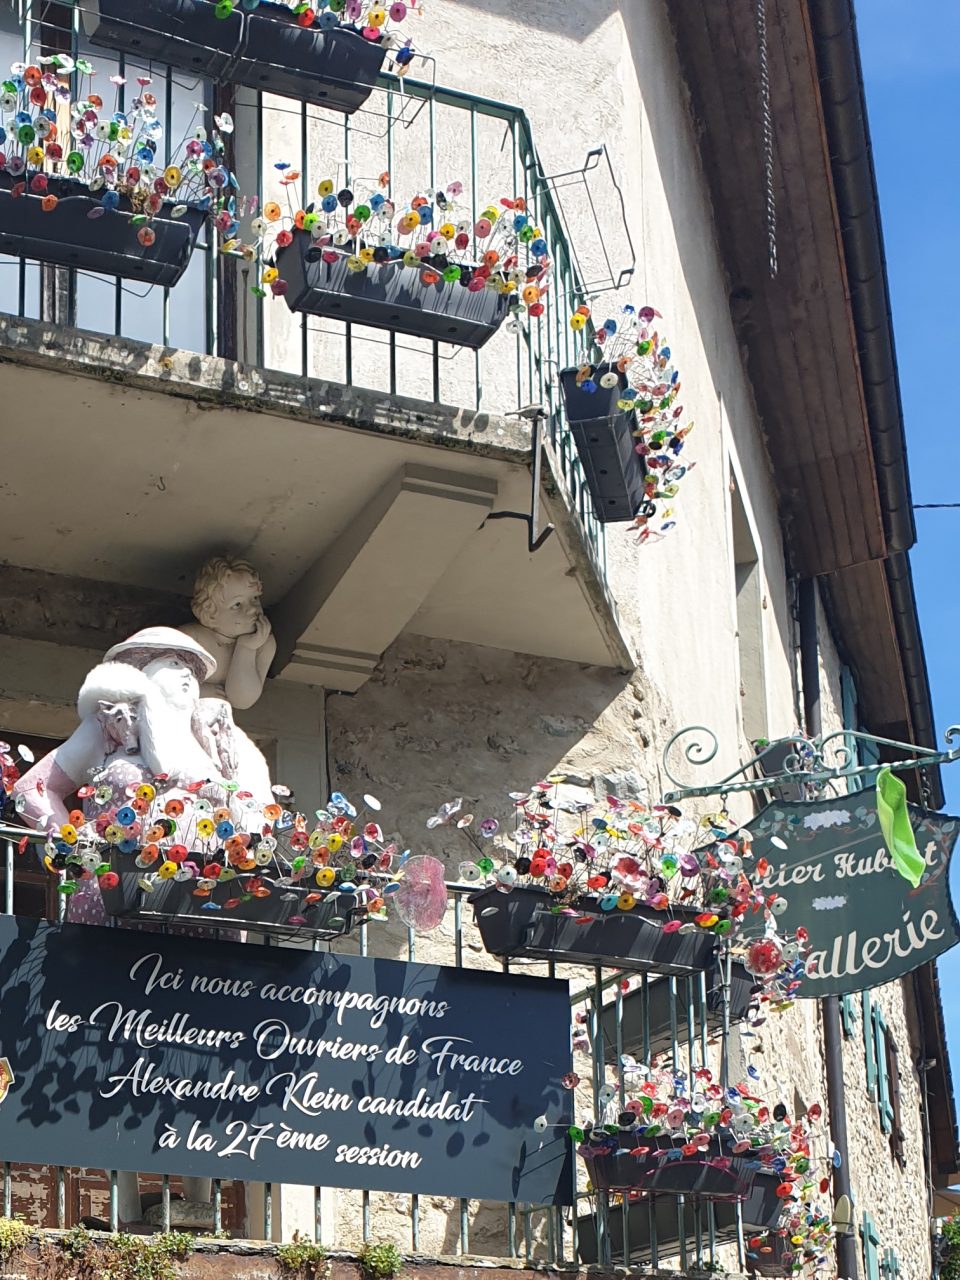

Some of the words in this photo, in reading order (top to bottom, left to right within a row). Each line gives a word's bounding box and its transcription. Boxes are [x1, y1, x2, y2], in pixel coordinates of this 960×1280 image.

[834, 841, 938, 879] Hubt
[130, 953, 184, 996] Ici
[190, 975, 256, 998] nous
[260, 983, 449, 1029] accompagnons
[46, 1000, 86, 1033] les
[89, 1001, 247, 1049] Meilleurs
[253, 1018, 382, 1063] Ouvriers
[385, 1035, 419, 1065] de
[421, 1035, 523, 1076] France
[99, 1057, 261, 1102] Alexandre
[265, 1071, 353, 1117] Klein
[357, 1088, 490, 1122] candidat
[158, 1122, 182, 1149] à
[186, 1120, 218, 1152] la
[335, 1144, 423, 1169] session
